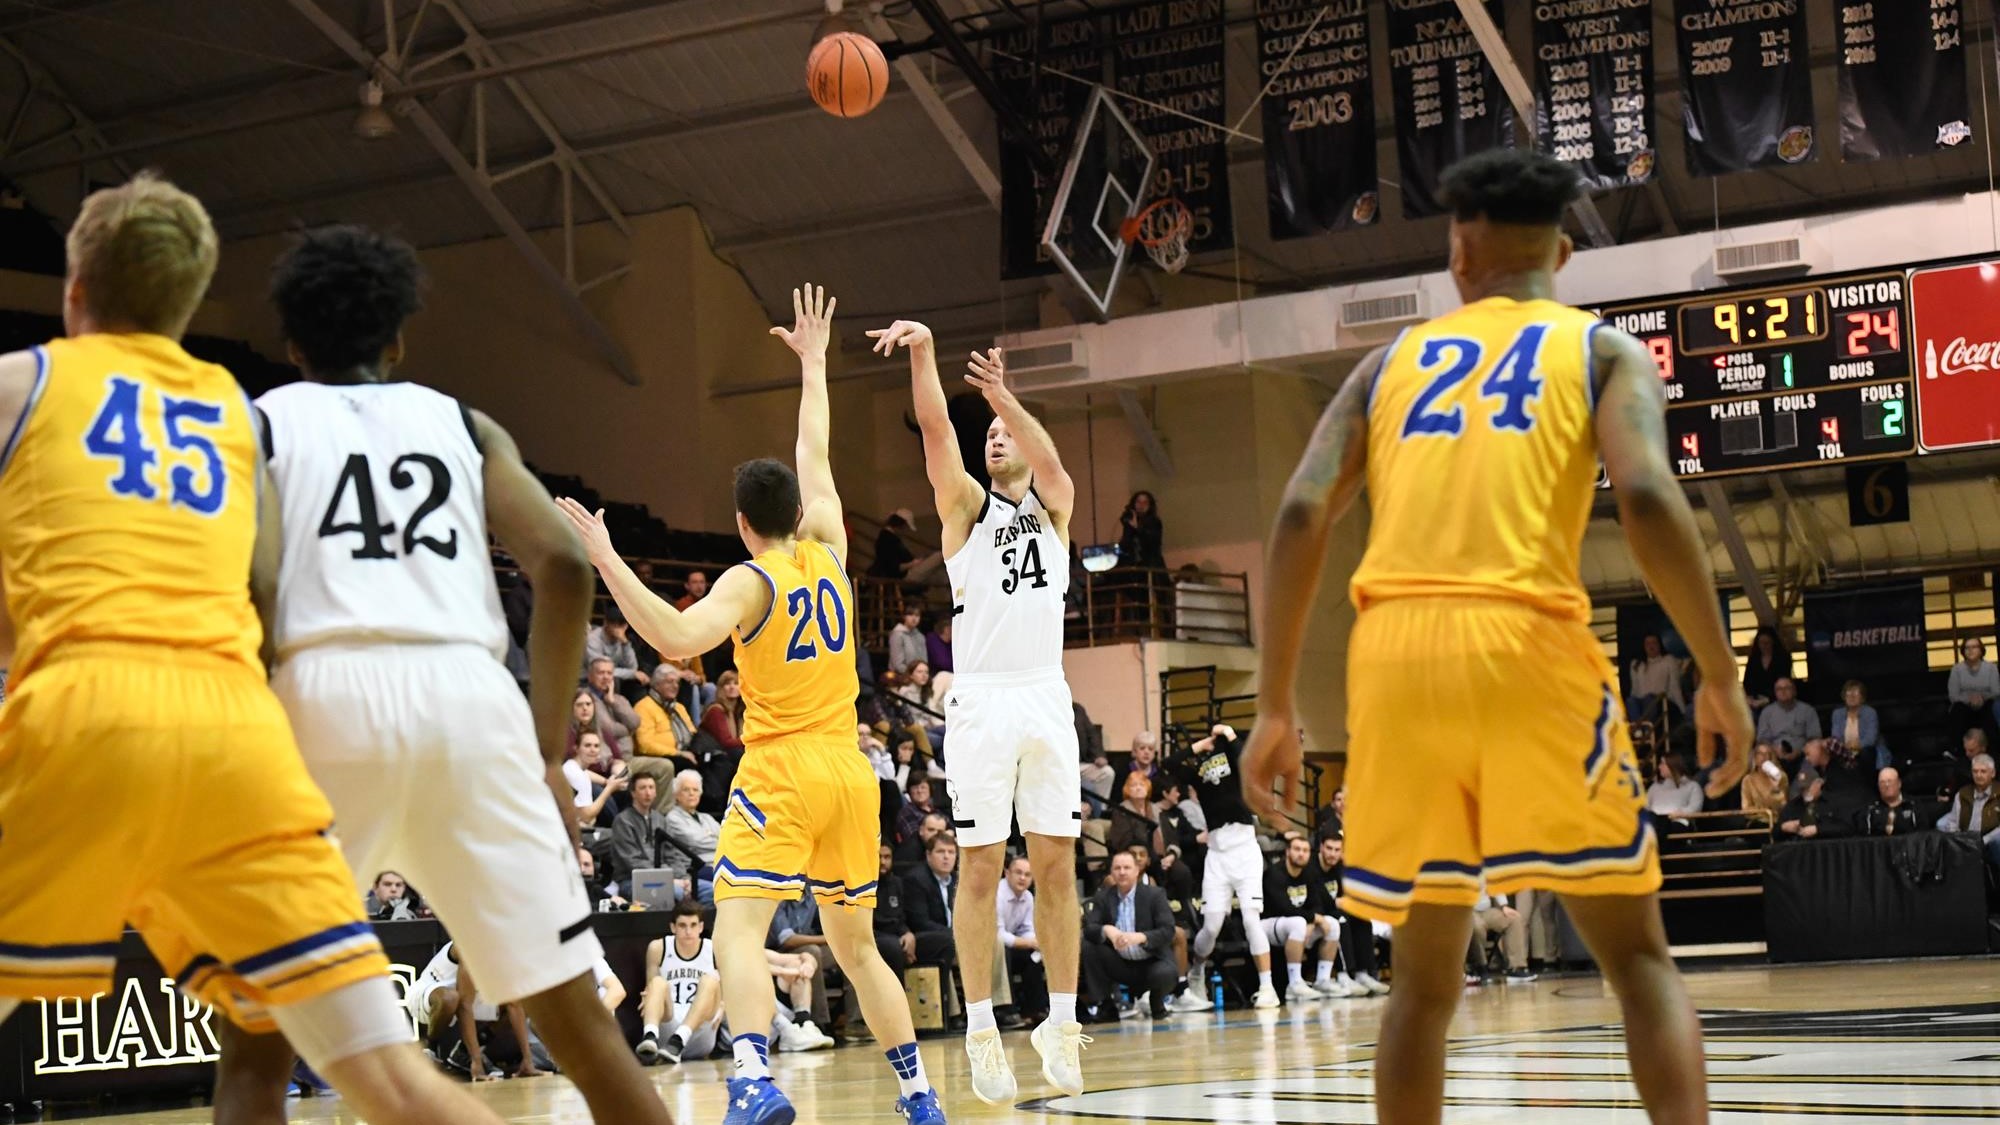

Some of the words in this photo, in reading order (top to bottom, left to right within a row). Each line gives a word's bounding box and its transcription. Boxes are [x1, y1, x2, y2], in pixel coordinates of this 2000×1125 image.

[1116, 5, 1162, 36] LADY
[1564, 16, 1619, 38] WEST
[1681, 2, 1797, 31] CHAMPIONS
[1309, 22, 1365, 46] SOUTH
[1539, 31, 1649, 60] CHAMPIONS
[1692, 37, 1733, 56] 2007
[1266, 64, 1368, 96] CHAMPIONS
[1550, 62, 1588, 81] 2002
[1614, 55, 1642, 72] 11-1
[1552, 82, 1590, 101] 2003
[1615, 75, 1643, 92] 11-1
[1288, 92, 1353, 131] 2003
[1552, 102, 1591, 121] 2004
[1611, 95, 1645, 113] 12-0
[1554, 123, 1591, 141] 2005
[1614, 115, 1645, 133] 13-1
[1555, 142, 1593, 161] 2006
[1614, 134, 1648, 154] 12-0
[1828, 281, 1902, 309] VISITOR
[1615, 310, 1667, 334] HOME
[1714, 294, 1816, 344] 9:21
[1847, 310, 1898, 356] 24
[1727, 352, 1754, 366] POSS
[1783, 354, 1793, 387] 1
[1829, 361, 1875, 381] BONUS
[1399, 321, 1557, 443] 24
[1717, 364, 1766, 383] PERIOD
[1861, 383, 1904, 402] FOULS
[1711, 400, 1760, 420] PLAYER
[1774, 393, 1816, 412] FOULS
[1882, 401, 1902, 435] 2
[1821, 419, 1838, 441] 4
[83, 374, 228, 518] 45
[1682, 433, 1698, 456] 4
[1817, 443, 1844, 459] TOL
[1678, 458, 1704, 474] TOL
[1863, 466, 1894, 518] 6
[318, 453, 458, 560] 42
[1002, 538, 1048, 595] 34
[785, 576, 848, 664] 20
[1833, 624, 1921, 649] BASKETBALL
[667, 968, 706, 981] HARDIN
[674, 982, 698, 1004] 12
